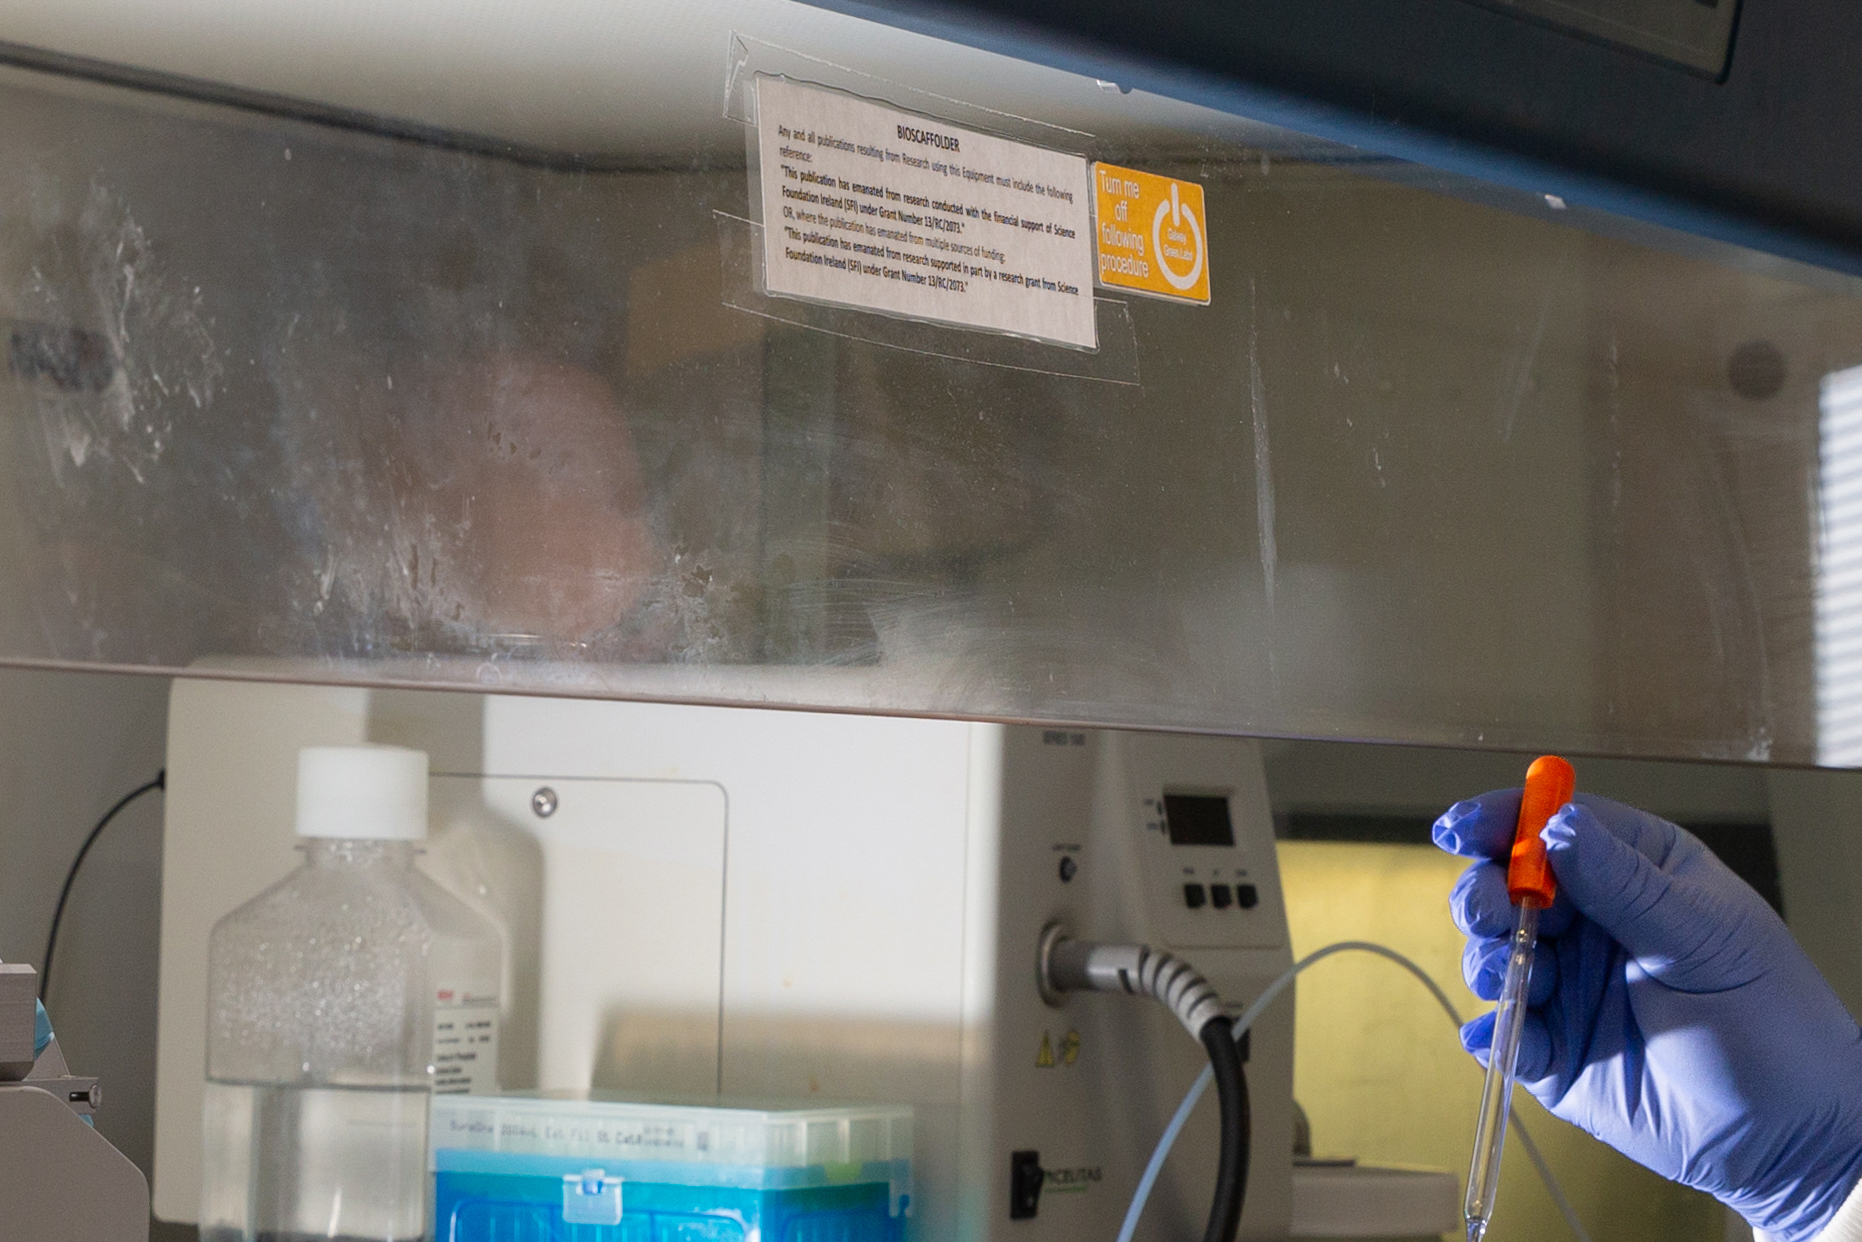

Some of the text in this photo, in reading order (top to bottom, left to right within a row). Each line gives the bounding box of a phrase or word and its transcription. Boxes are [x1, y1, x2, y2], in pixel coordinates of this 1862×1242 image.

[897, 125, 960, 152] BIOSCAFFOLDER
[777, 125, 791, 140] Any
[792, 130, 805, 141] and
[807, 131, 815, 143] all
[816, 135, 855, 152] publications
[856, 145, 883, 162] resulting
[884, 149, 900, 162] from
[901, 153, 929, 169] Research
[931, 162, 947, 176] using
[948, 165, 960, 176] this
[995, 177, 1010, 187] must
[1012, 179, 1033, 192] include
[1034, 184, 1045, 195] the
[1046, 186, 1073, 204] following
[1099, 170, 1139, 199] Turn me
[781, 186, 819, 203] Foundation
[820, 194, 843, 209] Ireland
[843, 198, 858, 214] (SFI)
[859, 204, 878, 215] under
[878, 206, 897, 220] Grant
[897, 211, 923, 225] Number
[799, 171, 836, 187] publication
[837, 177, 850, 190] has
[885, 187, 901, 201] from
[902, 195, 929, 207] research
[931, 201, 963, 215] conducted
[965, 207, 979, 218] with
[980, 209, 991, 221] the
[993, 211, 1019, 226] financial
[1020, 220, 1043, 232] support
[1045, 223, 1052, 233] of
[1053, 225, 1075, 239] Science
[1115, 200, 1128, 222] off
[795, 210, 816, 223] where
[817, 213, 828, 226] the
[829, 217, 864, 232] publication
[864, 223, 876, 236] has
[908, 232, 923, 244] from
[950, 244, 973, 255] sources
[973, 246, 980, 256] of
[1101, 222, 1144, 257] following
[784, 247, 823, 264] Foundation
[823, 255, 846, 269] Ireland
[847, 259, 862, 274] (SFI)
[862, 264, 881, 276] under
[882, 266, 900, 280] Grant
[901, 270, 926, 284] Number
[802, 232, 838, 248] publication
[839, 237, 851, 250] has
[885, 247, 901, 260] from
[902, 253, 929, 266] research
[930, 259, 961, 272] supported
[962, 262, 969, 274] in
[969, 267, 983, 277] part
[983, 267, 992, 281] by
[992, 270, 997, 280] a
[998, 273, 1023, 284] research
[1024, 277, 1040, 288] grant
[1041, 278, 1056, 291] from
[1057, 281, 1078, 295] Science
[1100, 253, 1149, 279] procedure
